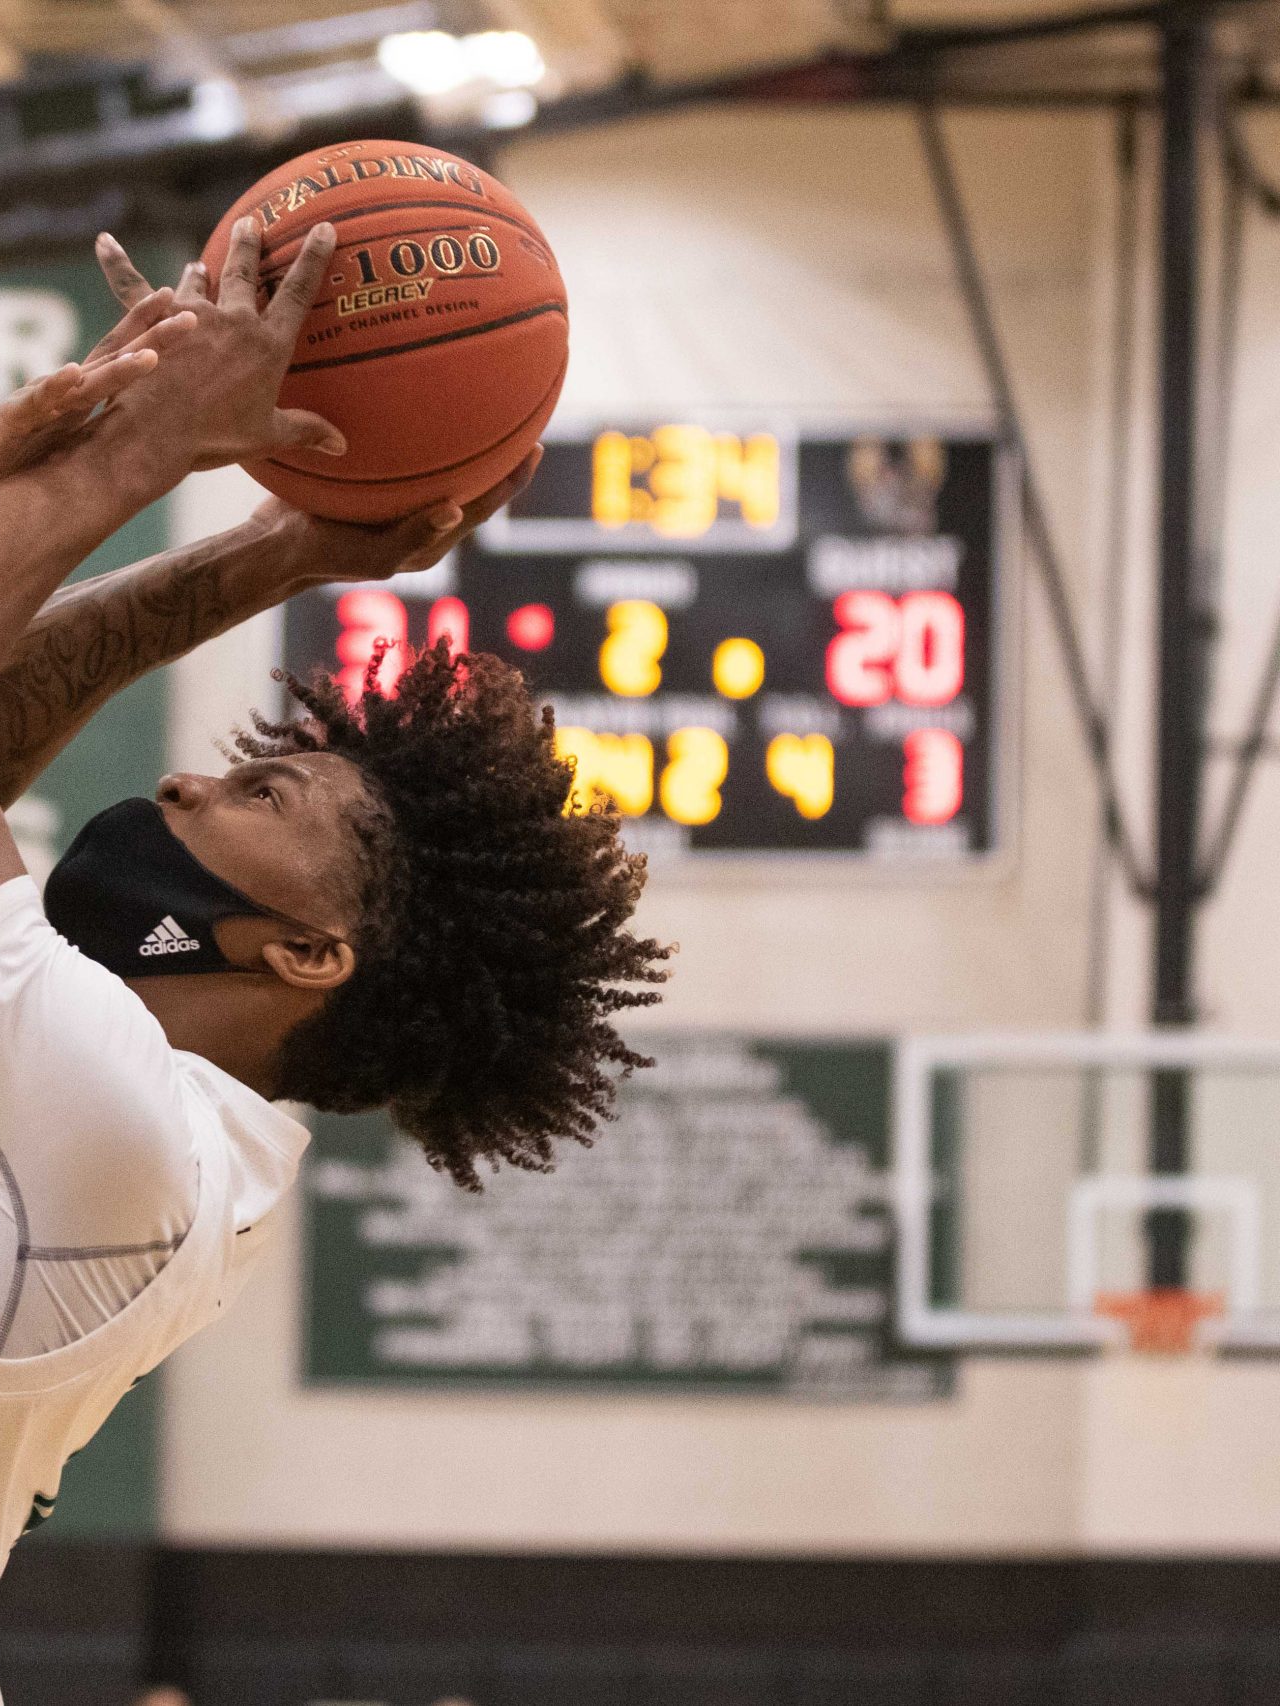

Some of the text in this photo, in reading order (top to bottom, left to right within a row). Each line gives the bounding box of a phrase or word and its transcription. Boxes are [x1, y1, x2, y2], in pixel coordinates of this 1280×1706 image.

[256, 154, 490, 232] PALDING
[331, 232, 502, 288] -1000
[307, 299, 481, 346] DEEP CHANNEL DESIGN
[338, 278, 435, 317] LEGACY
[592, 424, 780, 539] 1:34
[599, 599, 669, 698] 2
[825, 590, 966, 707] 20
[139, 938, 200, 956] adidas
